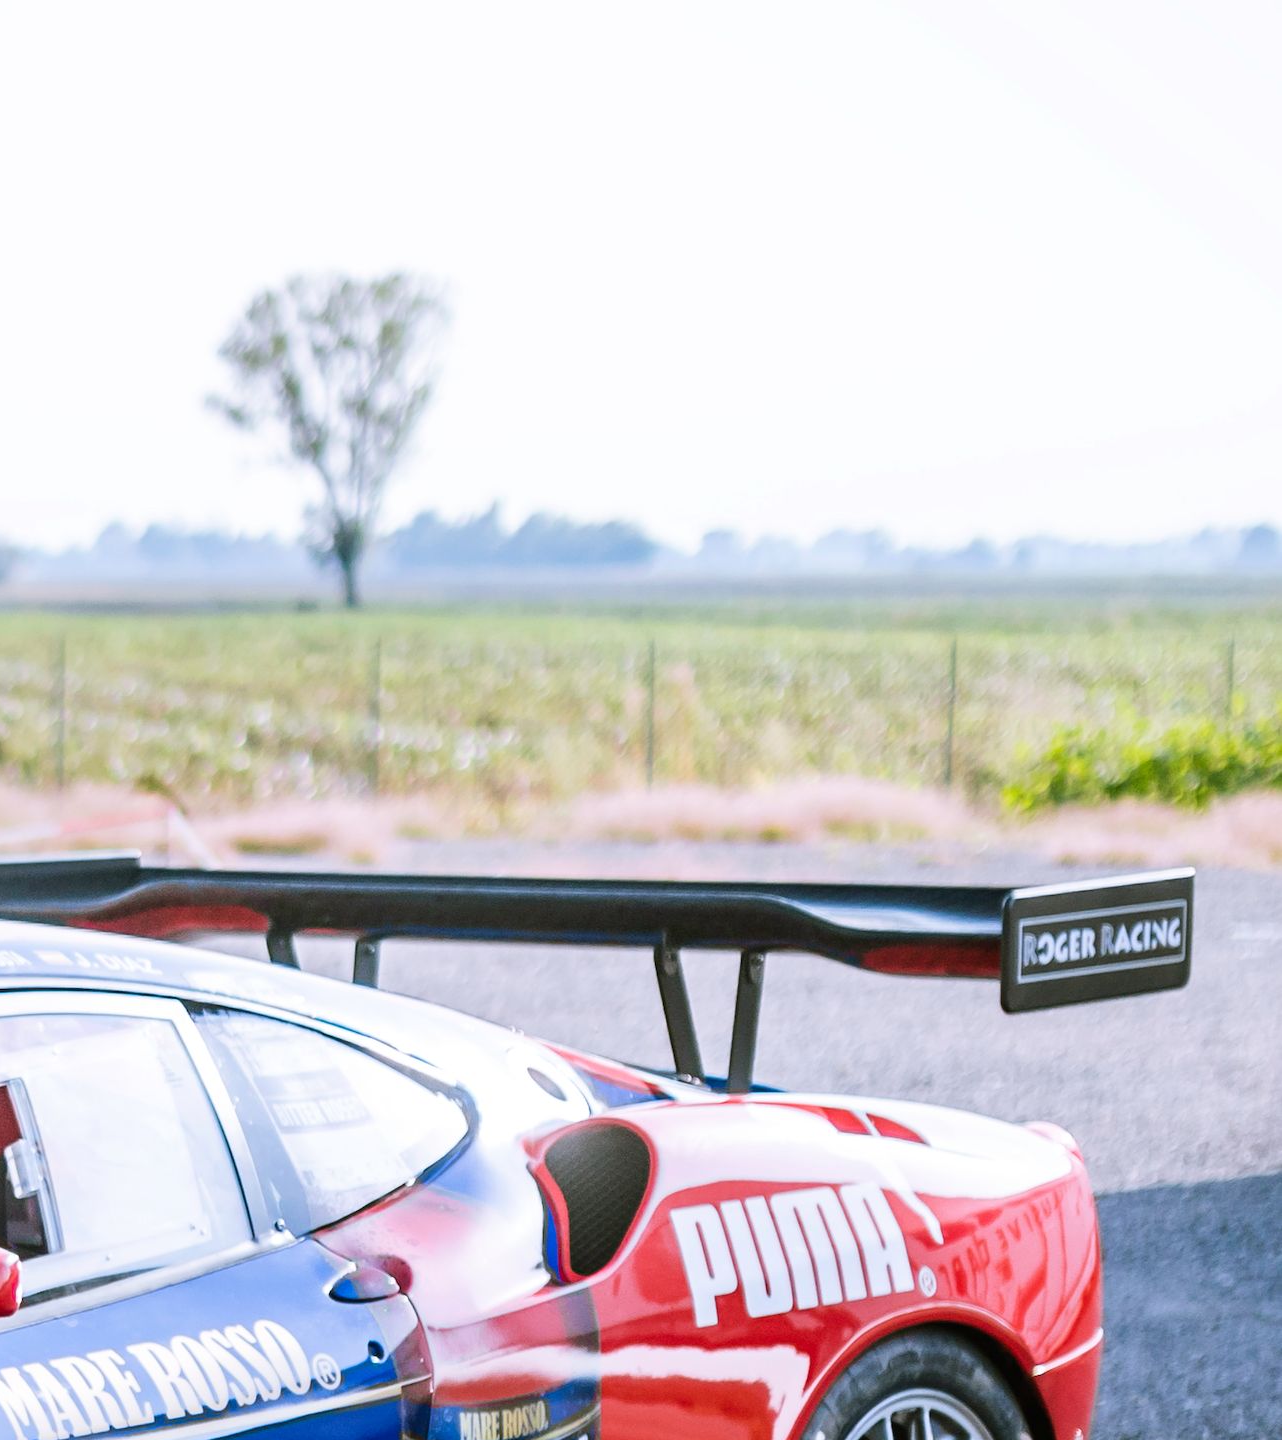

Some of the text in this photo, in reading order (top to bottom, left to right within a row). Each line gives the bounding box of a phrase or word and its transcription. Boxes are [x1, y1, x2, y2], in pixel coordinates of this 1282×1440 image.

[1023, 916, 1182, 966] ROGER RACING
[670, 1182, 915, 1328] PUMA
[128, 1319, 315, 1421] ROSSO
[502, 1400, 546, 1440] ROSSO
